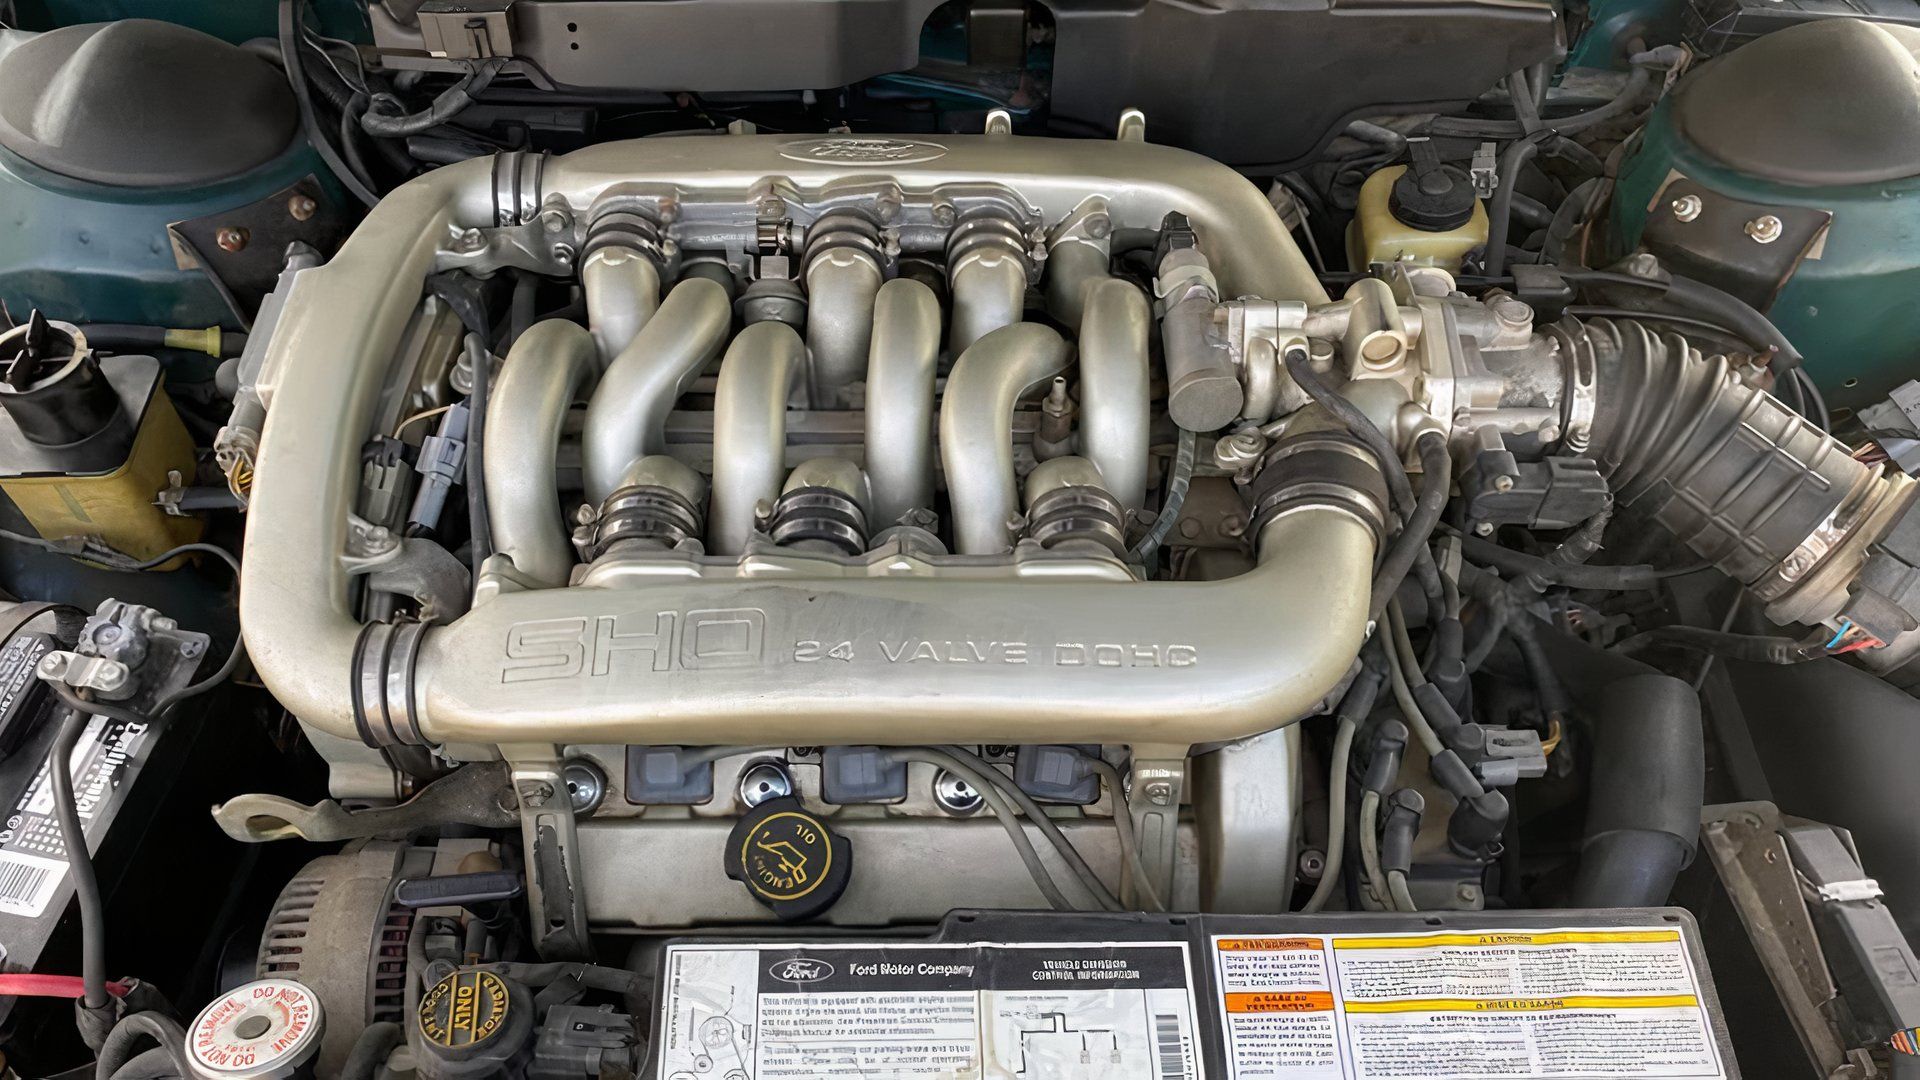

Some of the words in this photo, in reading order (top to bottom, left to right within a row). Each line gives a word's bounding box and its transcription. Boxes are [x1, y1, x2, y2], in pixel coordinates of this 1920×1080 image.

[502, 607, 766, 684] SHO
[794, 641, 854, 663] 24
[879, 640, 1027, 664] VALVE
[1055, 642, 1198, 667] DOHC
[796, 824, 817, 846] OIL
[253, 986, 275, 999] DO
[454, 986, 473, 1031] ONLY
[233, 1053, 255, 1067] DO
